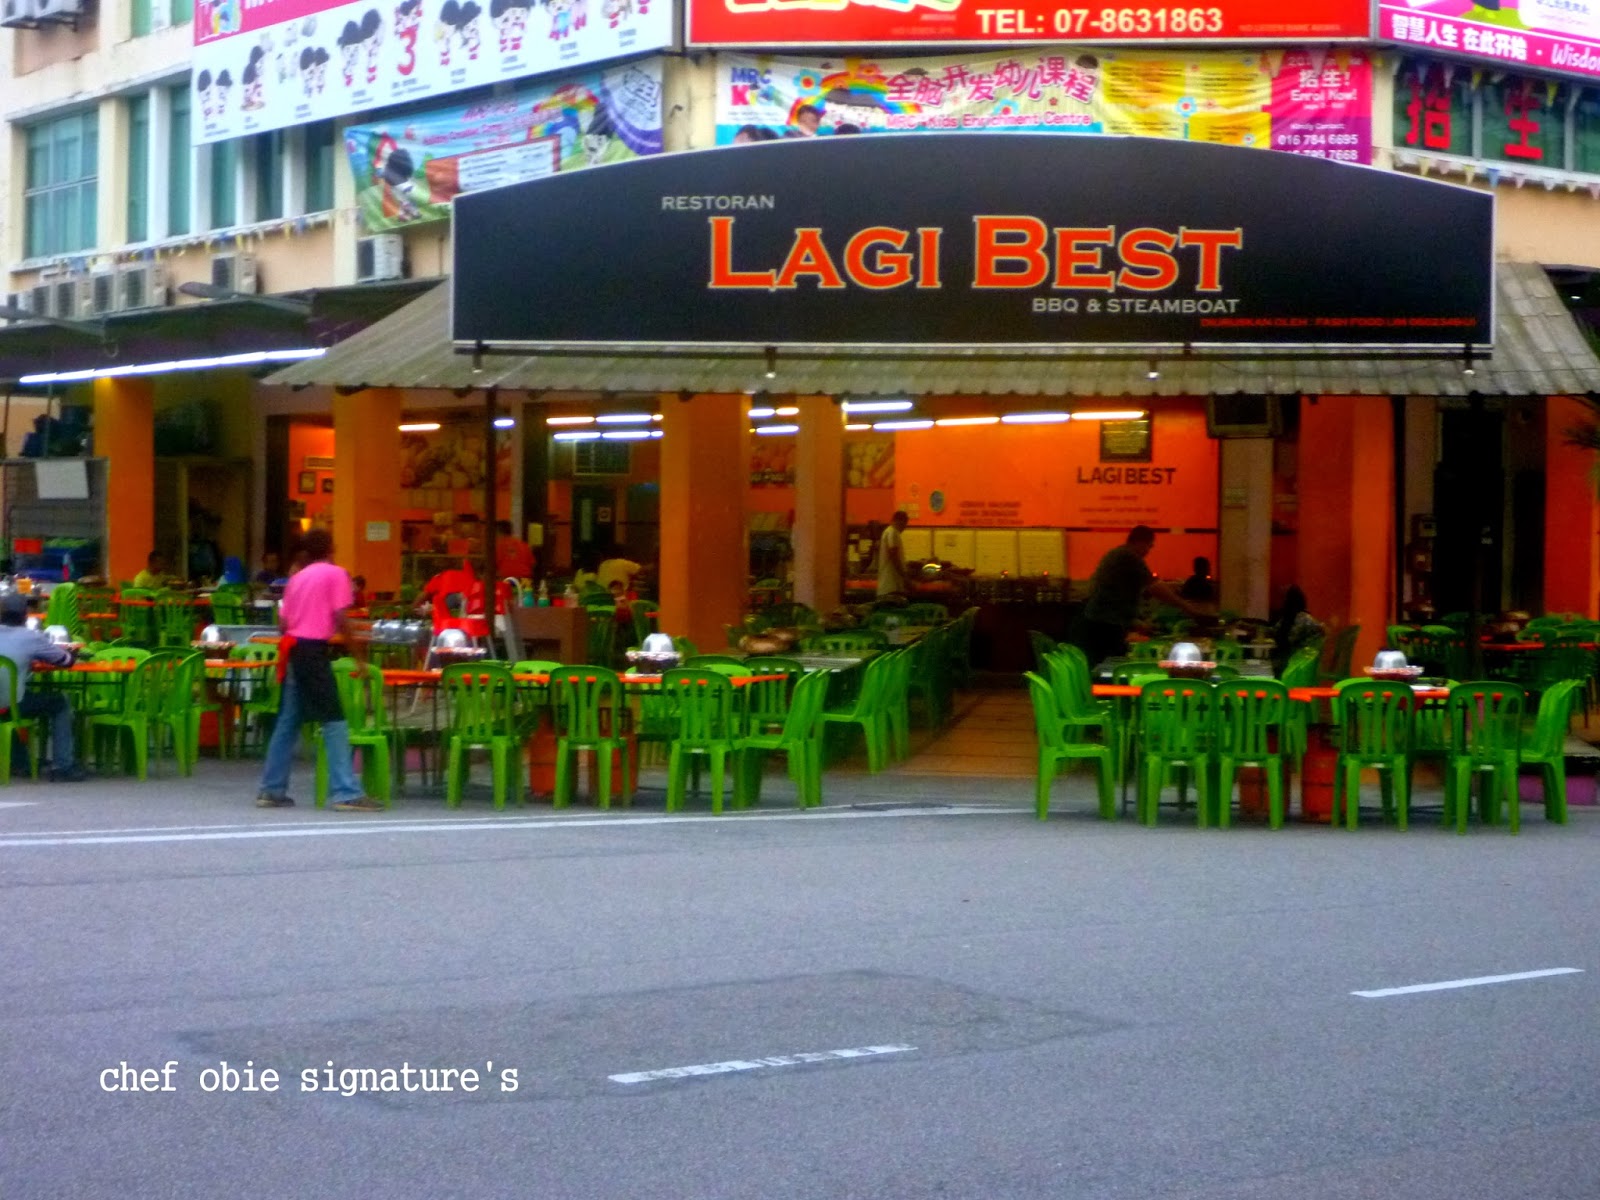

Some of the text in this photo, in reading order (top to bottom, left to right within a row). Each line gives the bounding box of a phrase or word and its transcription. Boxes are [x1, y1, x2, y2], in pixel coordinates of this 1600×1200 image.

[976, 8, 1223, 34] TEL: 07-8631863
[1392, 14, 1528, 61] 智慧人生 在此开始
[731, 68, 772, 84] MRC
[1044, 110, 1092, 125] Centre
[661, 195, 776, 210] RESTORAN
[708, 214, 1244, 293] LAGI BEST
[1032, 298, 1240, 314] BBQ & STEAMBOAT
[1077, 467, 1176, 485] LAGI BEST
